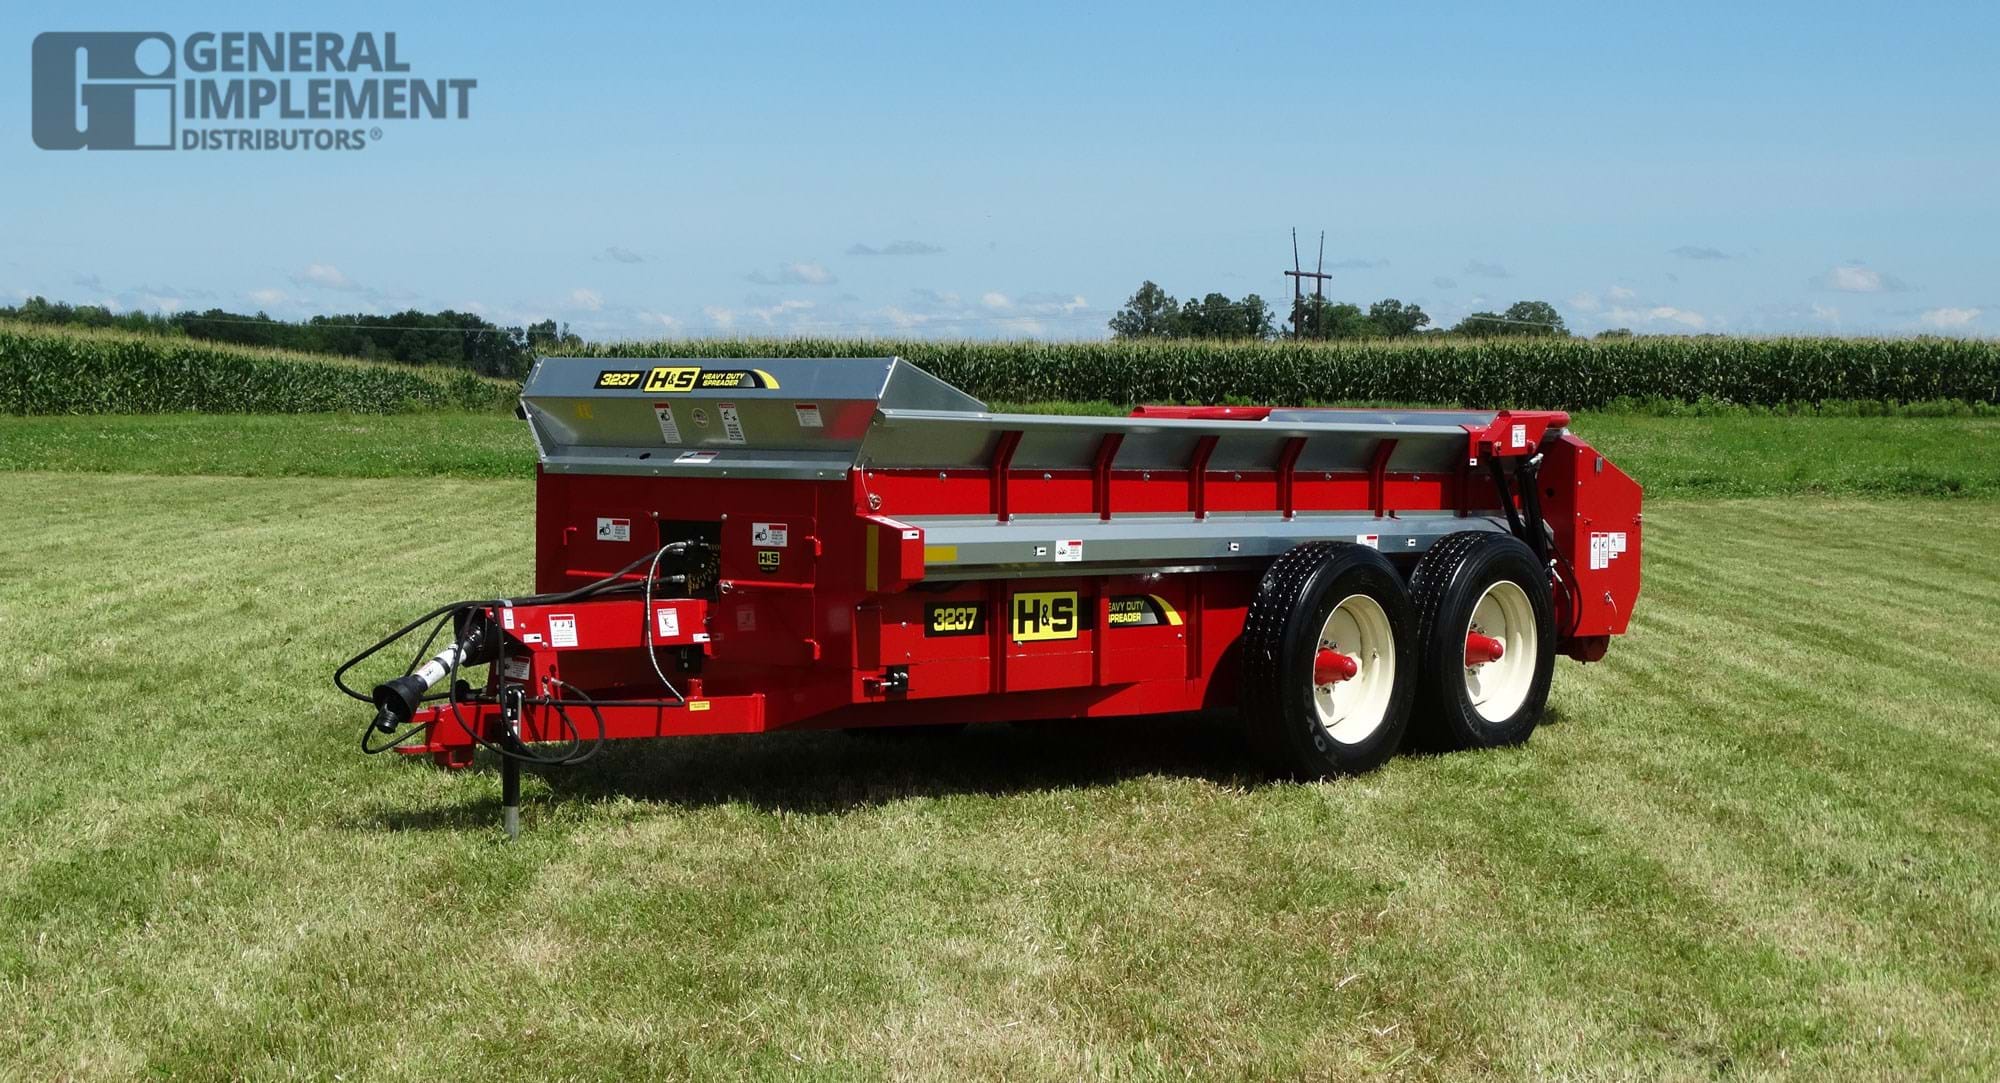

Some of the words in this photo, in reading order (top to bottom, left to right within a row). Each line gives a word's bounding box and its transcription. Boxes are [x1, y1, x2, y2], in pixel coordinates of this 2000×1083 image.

[600, 373, 640, 386] 3237
[648, 371, 696, 388] H&S
[726, 372, 746, 380] DUTY
[702, 379, 739, 387] SPREADER
[1108, 601, 1125, 611] EAVY
[1126, 600, 1145, 610] DUTY
[933, 607, 978, 632] 3237
[1017, 598, 1074, 635] H&S
[1108, 612, 1142, 623] PREADER
